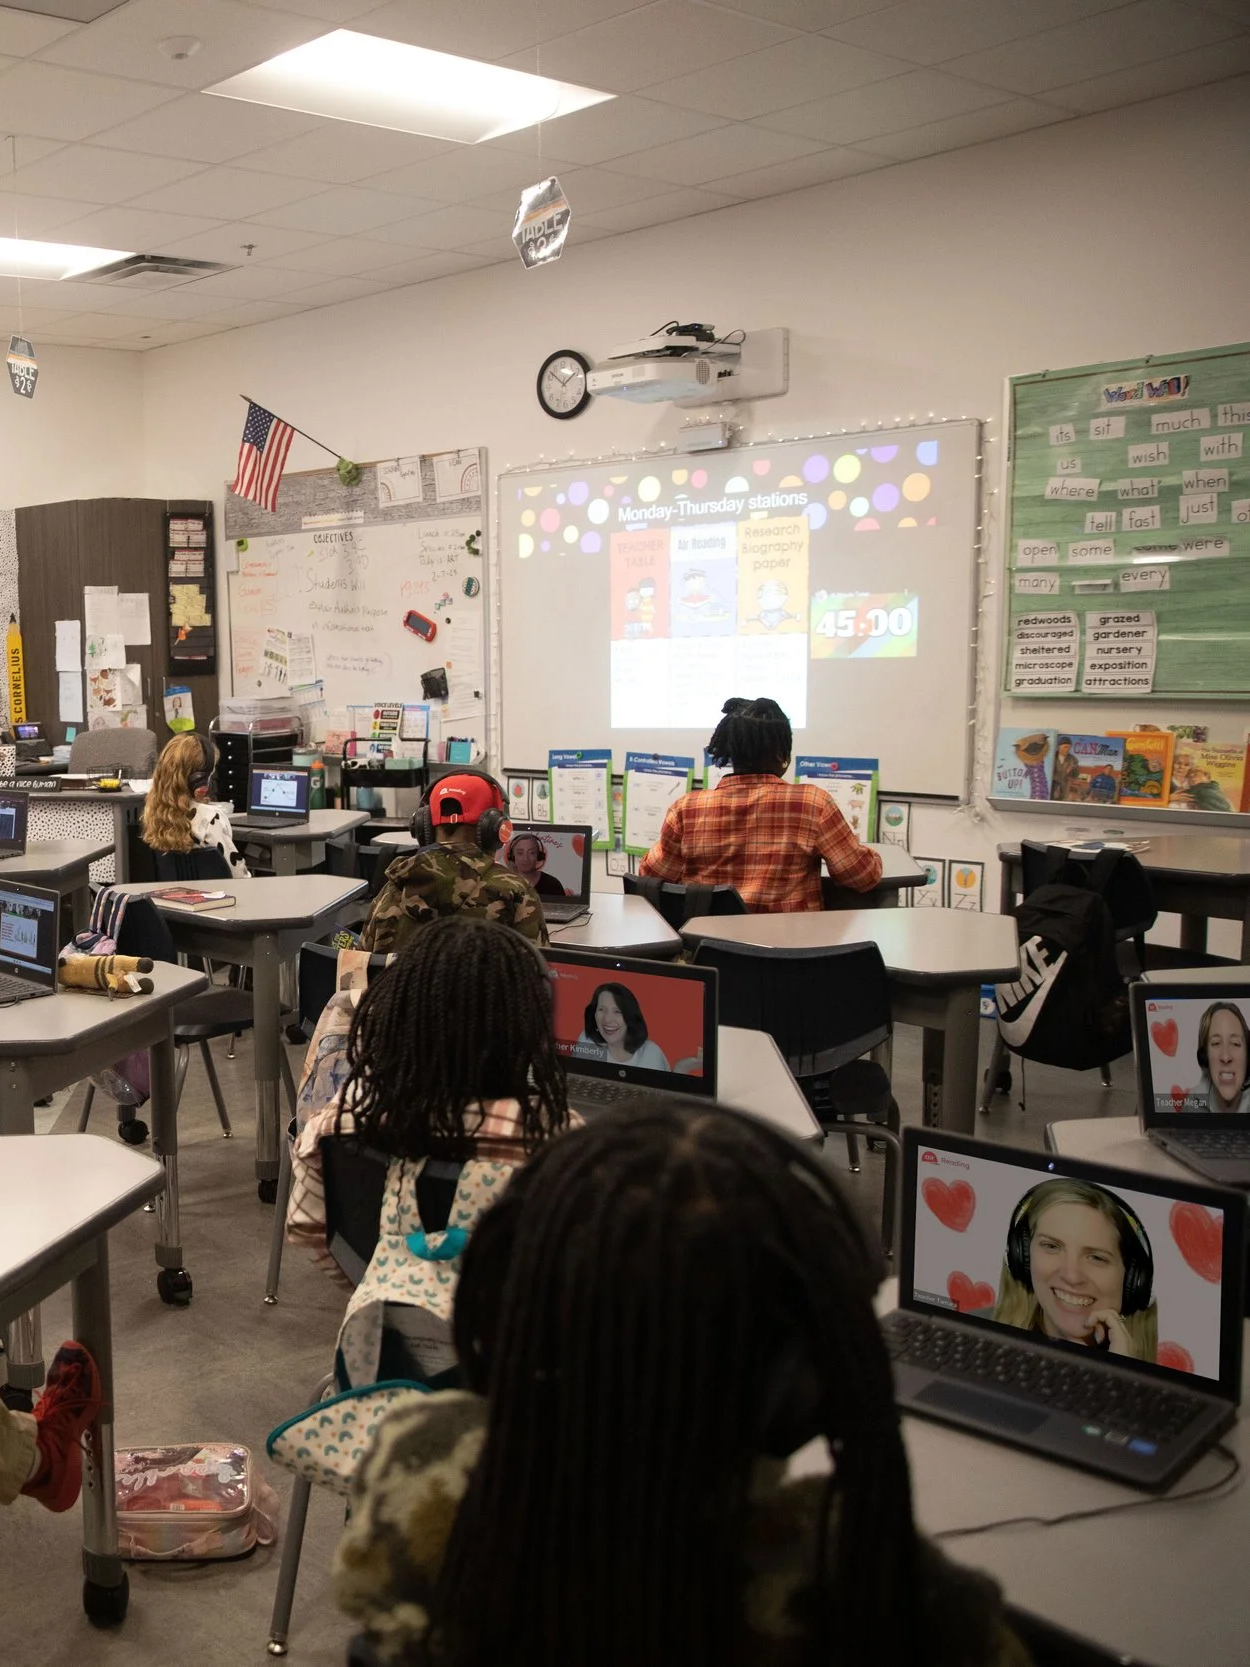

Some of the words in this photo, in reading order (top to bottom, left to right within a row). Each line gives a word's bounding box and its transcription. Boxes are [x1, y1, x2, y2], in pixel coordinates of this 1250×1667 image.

[522, 214, 563, 242] TABLE
[11, 363, 35, 381] TABLE
[20, 377, 26, 394] 2
[1094, 418, 1112, 436] sit
[1156, 412, 1201, 432] much
[1056, 429, 1072, 443] its
[1132, 444, 1167, 464] wish
[1204, 439, 1238, 456] with
[1061, 459, 1077, 470] us
[1184, 472, 1226, 489] when
[1050, 478, 1095, 498] where
[1119, 479, 1157, 497] what
[618, 497, 744, 522] Monday-Thursday
[748, 492, 808, 509] stations
[1182, 496, 1215, 524] just
[1090, 514, 1113, 532] tell
[1129, 510, 1157, 529] fast
[313, 531, 354, 544] OBJECTIVES
[744, 524, 800, 538] Research
[617, 538, 664, 554] TEACHER
[692, 536, 726, 550] Reading
[742, 540, 803, 556] Biography
[1183, 539, 1224, 552] were
[1023, 545, 1057, 563] open
[1072, 545, 1112, 558] some
[623, 556, 657, 568] TABLE
[753, 557, 791, 571] paper
[1018, 578, 1056, 593] many
[1122, 569, 1167, 588] every
[1017, 615, 1072, 626] redwoods
[1099, 614, 1141, 626] grazed
[1017, 630, 1074, 640] discouraged
[1093, 630, 1148, 641] gardener
[1020, 645, 1071, 655] sheltered
[1096, 646, 1143, 656] nursery
[1015, 661, 1074, 670] microscope
[1090, 661, 1148, 672] exposition
[11, 648, 23, 716] CORNELIUS
[1014, 676, 1072, 687] graduation
[1084, 677, 1149, 686] attractions
[1073, 742, 1099, 755] CAN
[0, 780, 8, 788] be
[16, 780, 32, 788] nice
[32, 780, 57, 788] human
[1007, 779, 1023, 790] UP!
[570, 1044, 605, 1058] Kimberly
[1155, 1097, 1183, 1107] Teacher
[1184, 1098, 1207, 1109] Megan
[941, 1157, 970, 1170] Reading
